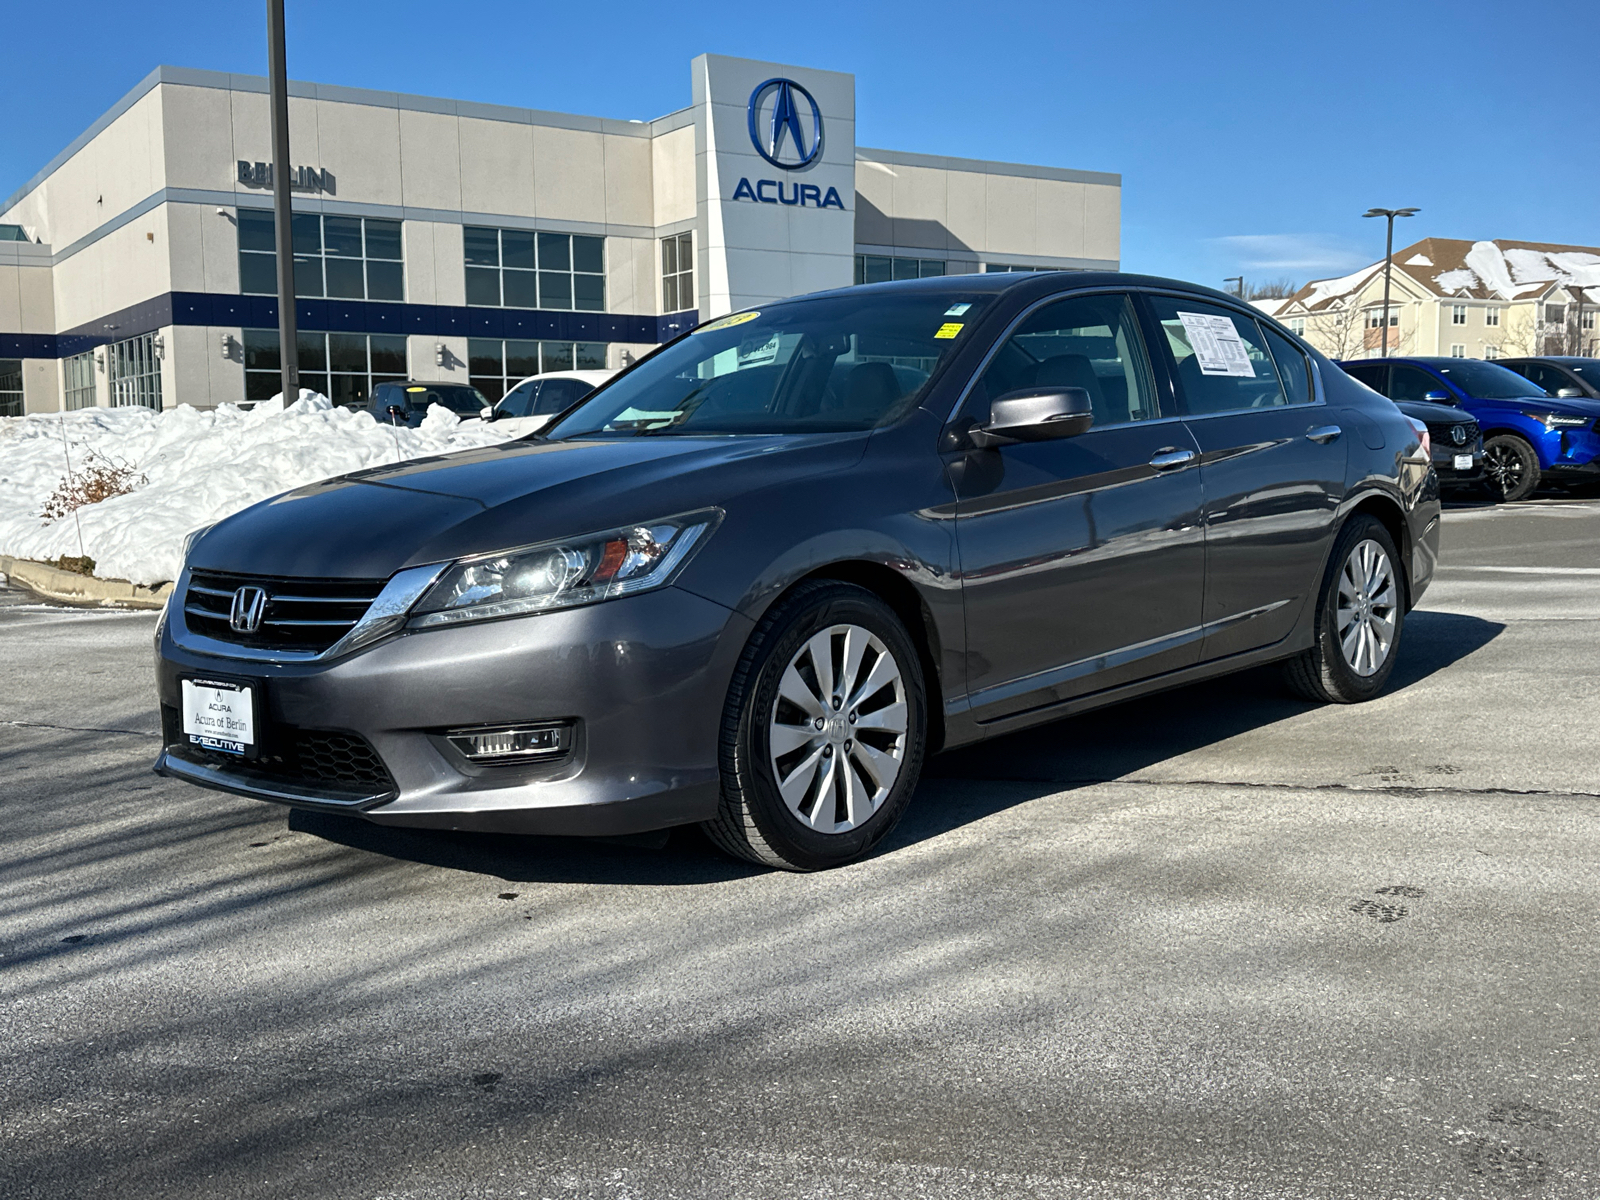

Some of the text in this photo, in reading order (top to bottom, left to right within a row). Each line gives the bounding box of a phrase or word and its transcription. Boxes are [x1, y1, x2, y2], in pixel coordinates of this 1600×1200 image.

[732, 177, 845, 209] ACURA
[208, 703, 232, 713] ACURA
[194, 712, 247, 731] Acura of Berlin
[189, 735, 245, 752] EXECUTIVE
